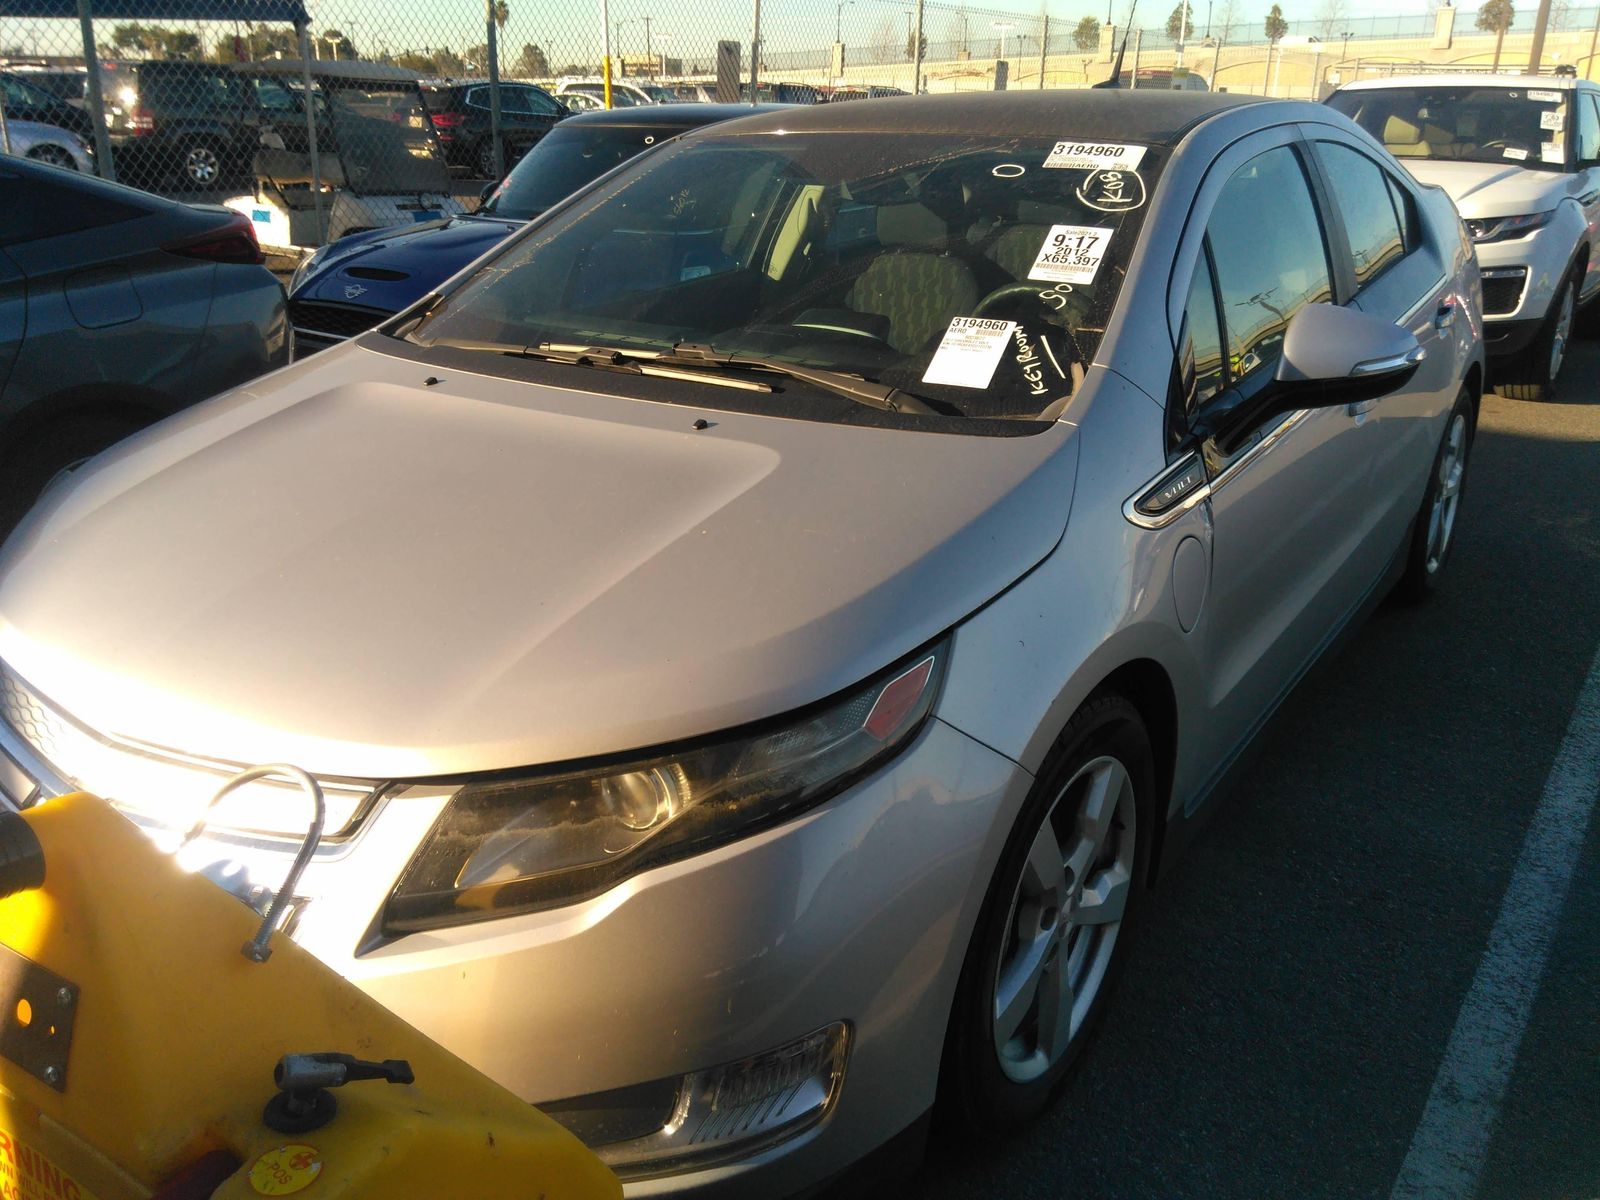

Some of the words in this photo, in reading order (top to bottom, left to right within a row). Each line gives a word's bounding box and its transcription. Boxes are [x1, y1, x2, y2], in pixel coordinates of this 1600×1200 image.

[1054, 145, 1125, 157] 3194960
[1053, 234, 1099, 249] 9:17
[1055, 247, 1088, 256] 2012
[1042, 254, 1099, 266] X65.397
[953, 317, 1008, 331] 3194960
